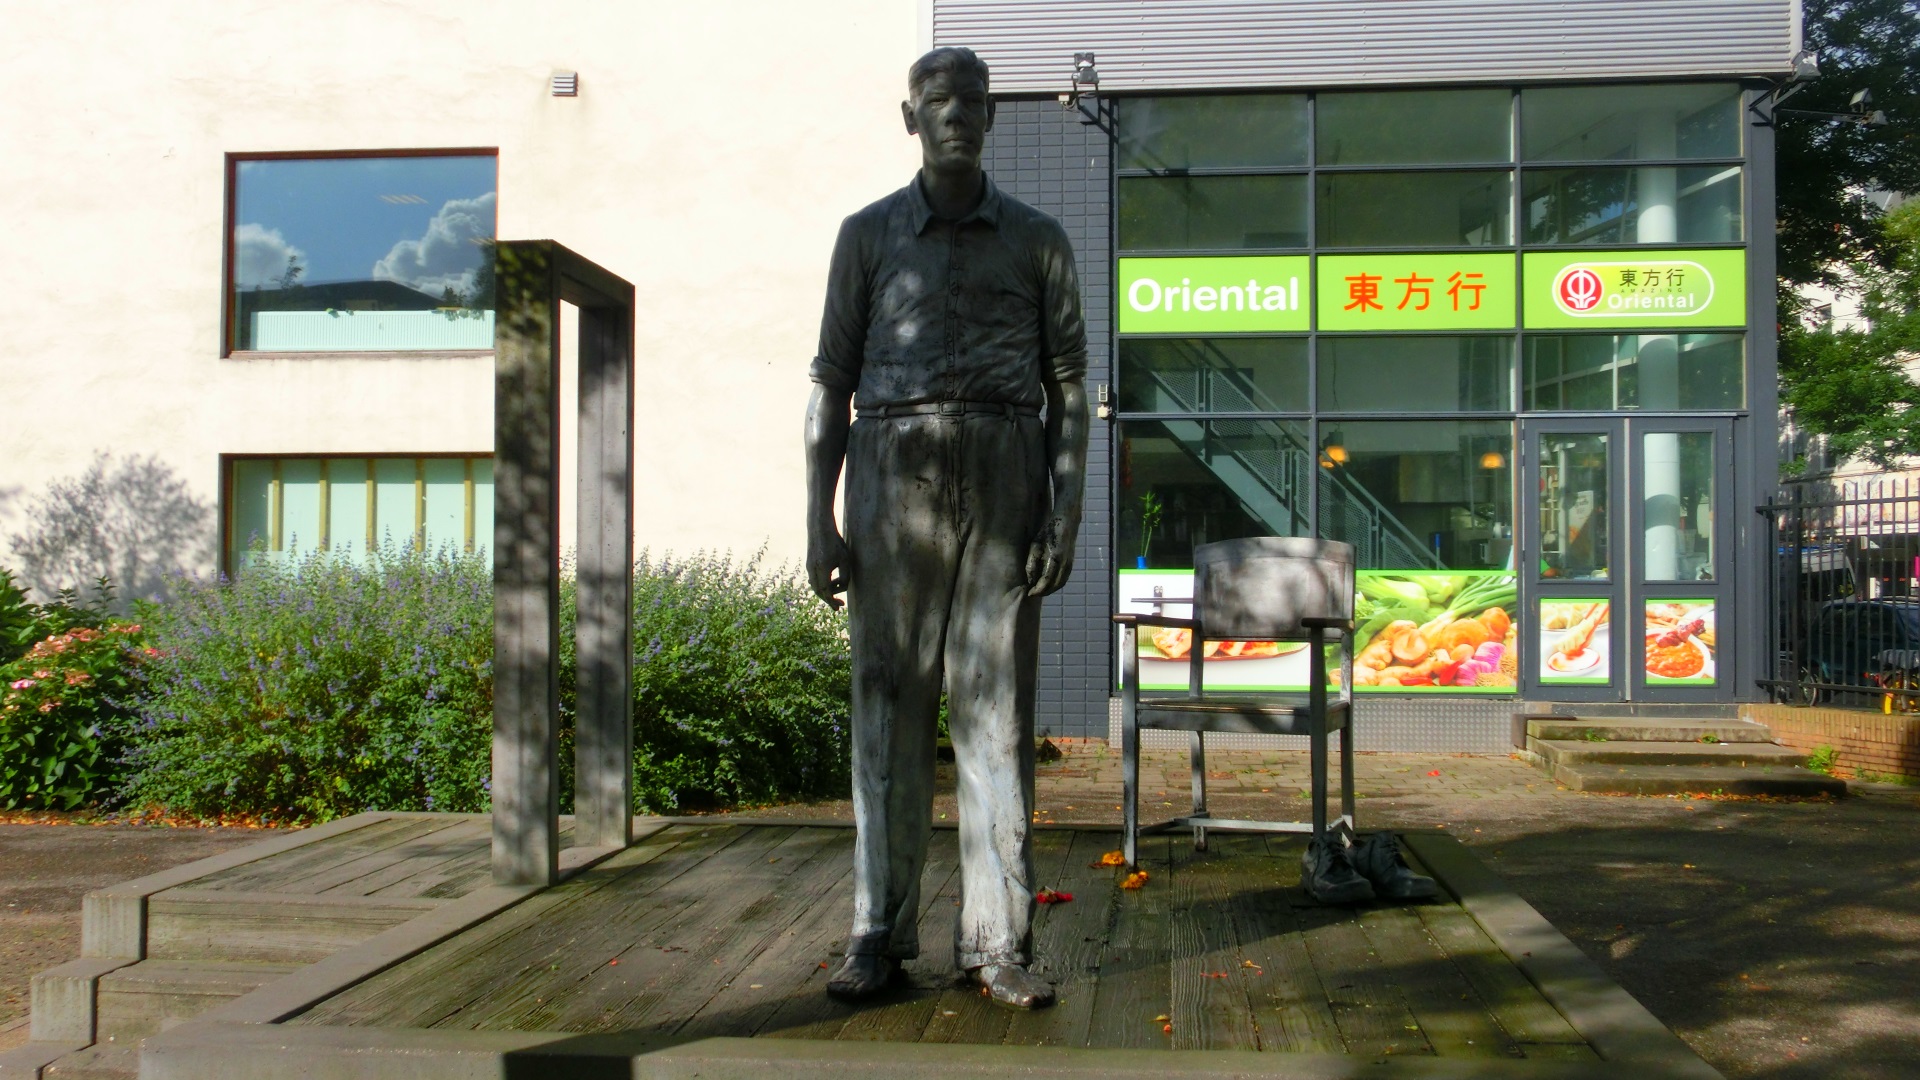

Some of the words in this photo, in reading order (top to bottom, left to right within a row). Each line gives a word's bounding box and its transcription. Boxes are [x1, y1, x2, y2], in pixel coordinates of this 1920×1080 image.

[1619, 268, 1685, 287] 東方行
[1127, 277, 1299, 313] Oriental
[1343, 272, 1487, 313] 東方行
[1607, 292, 1694, 309] Oriental
